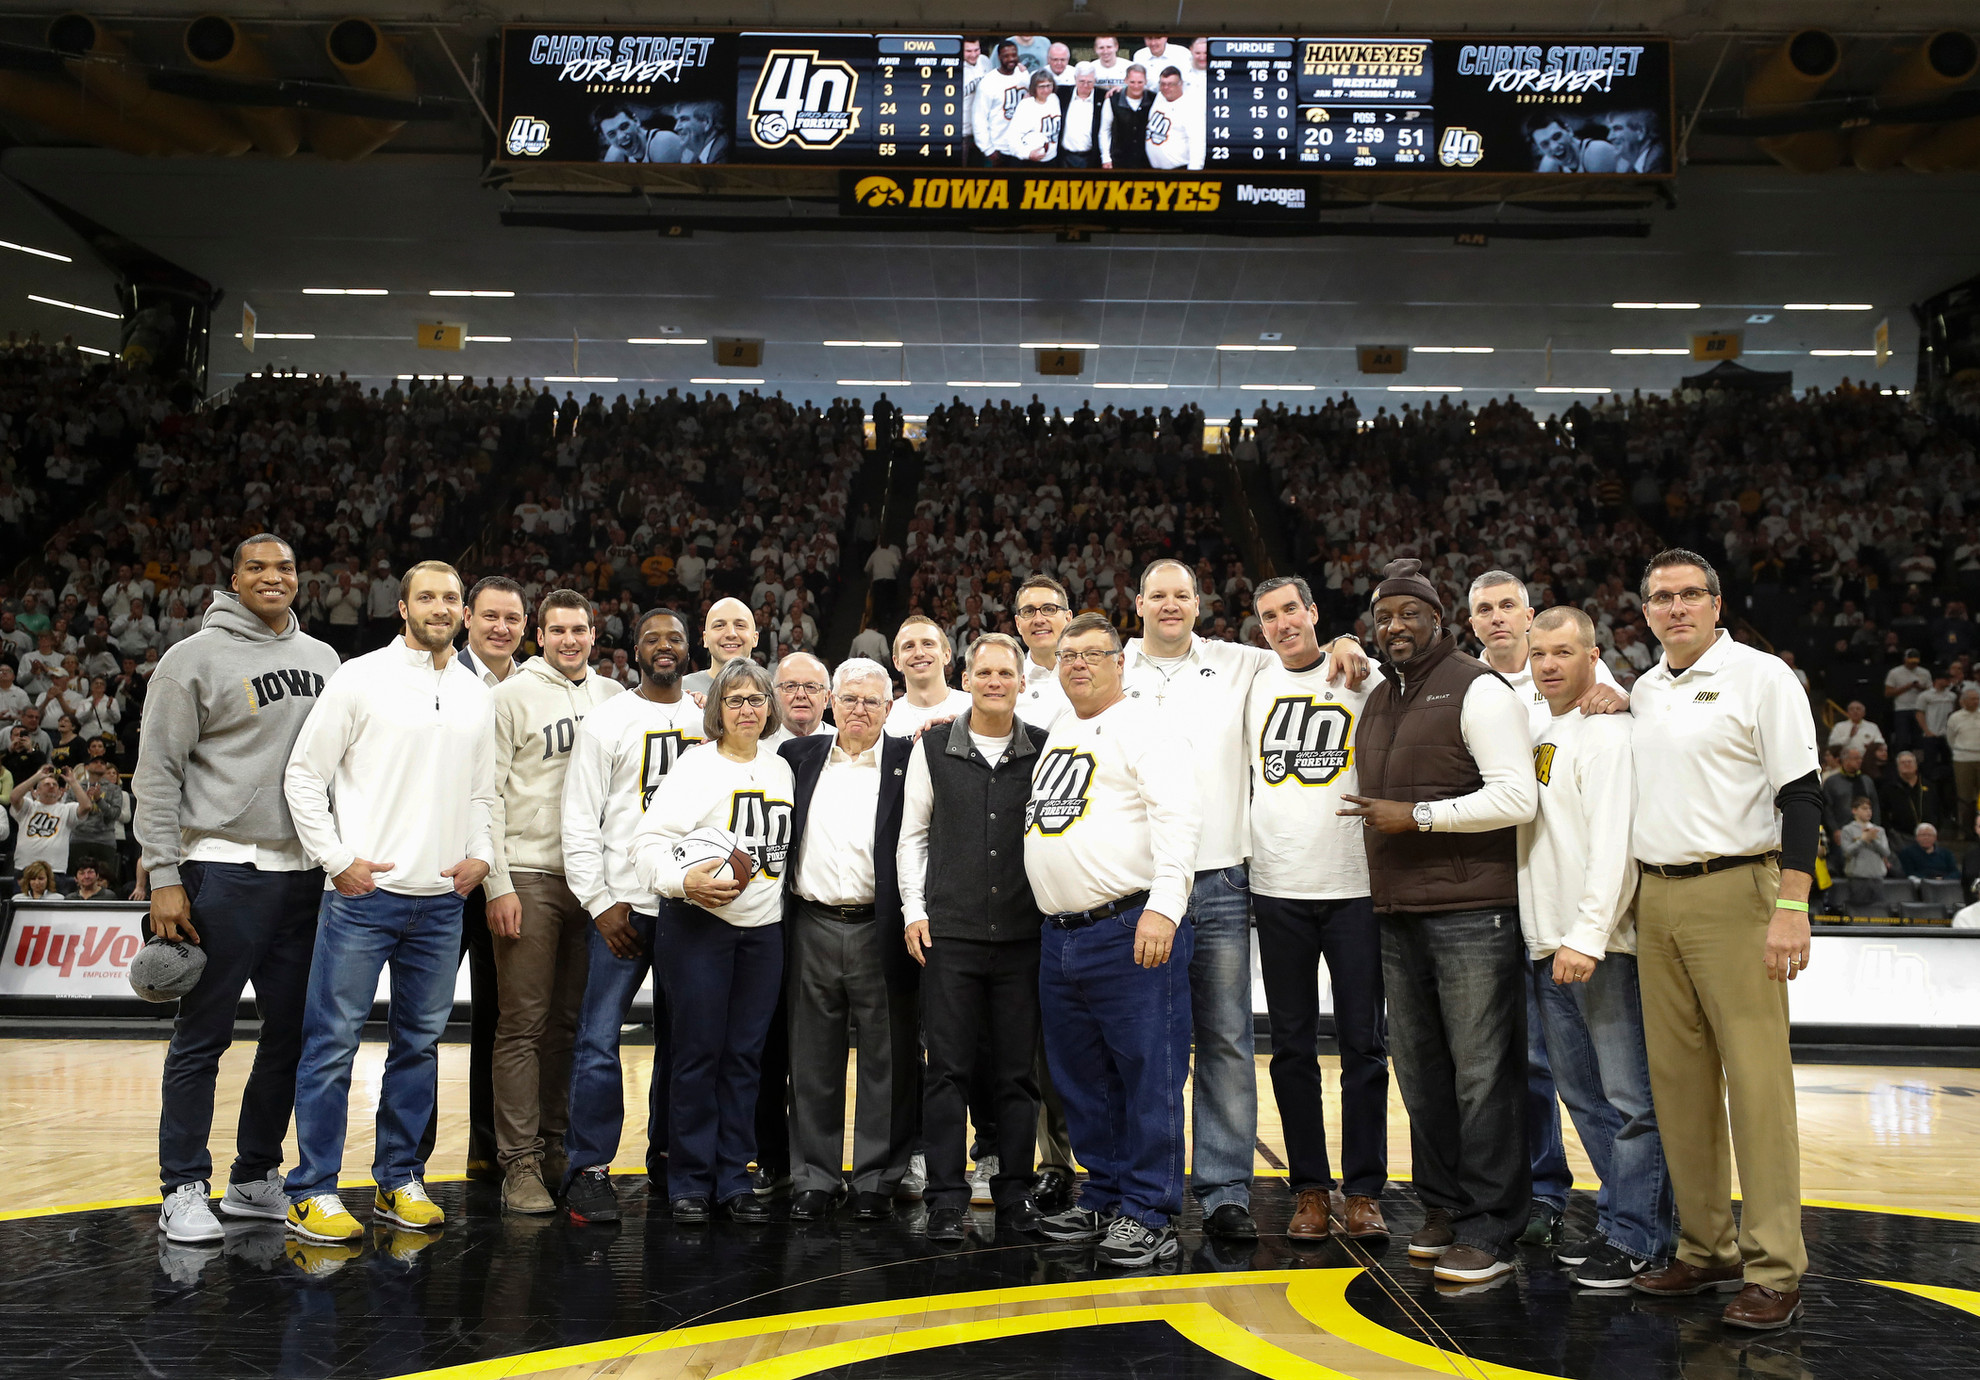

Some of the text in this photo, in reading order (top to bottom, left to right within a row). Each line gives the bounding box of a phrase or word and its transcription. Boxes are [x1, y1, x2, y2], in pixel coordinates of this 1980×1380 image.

[529, 35, 715, 67] CHRIS STREET
[903, 41, 936, 52] IOWA
[1226, 42, 1275, 53] PURDUE
[1304, 44, 1427, 65] HAWKEYES
[1457, 45, 1645, 77] CHRIS STREET
[877, 57, 900, 66] PLAYER
[1209, 60, 1232, 69] PLAYER
[558, 56, 684, 83] FOREVER!
[884, 66, 954, 79] 2 0 1
[1216, 69, 1288, 82] 3 16 0
[1304, 65, 1424, 76] HOME EVENTS
[1332, 78, 1398, 88] WRESTLING
[1487, 66, 1614, 93] FOREVER!
[884, 84, 956, 97] 3 7 0
[1213, 87, 1288, 100] 11 5 0
[758, 58, 850, 141] 40
[879, 103, 955, 116] 24 0 0
[1213, 106, 1288, 119] 12 15 0
[795, 118, 849, 128] FOREVER
[1352, 112, 1376, 124] POSS
[510, 119, 546, 152] 40
[879, 124, 955, 136] 51 2 0
[1213, 127, 1288, 140] 14 3 0
[1304, 127, 1424, 147] 20 2:59 51
[878, 144, 953, 157] 55 4 1
[1443, 130, 1479, 163] 40
[1212, 147, 1287, 160] 23 0 1
[1353, 156, 1377, 166] 2ND
[908, 178, 1222, 211] IOWA HAWKEYES
[1237, 184, 1305, 205] Mycogen
[434, 329, 444, 341] C
[1694, 690, 1720, 701] IOWA
[1263, 700, 1346, 779] 40
[1294, 757, 1344, 766] FOREVER
[1033, 752, 1091, 829] 40
[1039, 805, 1081, 816] FOREVER
[14, 926, 147, 977] HyVe
